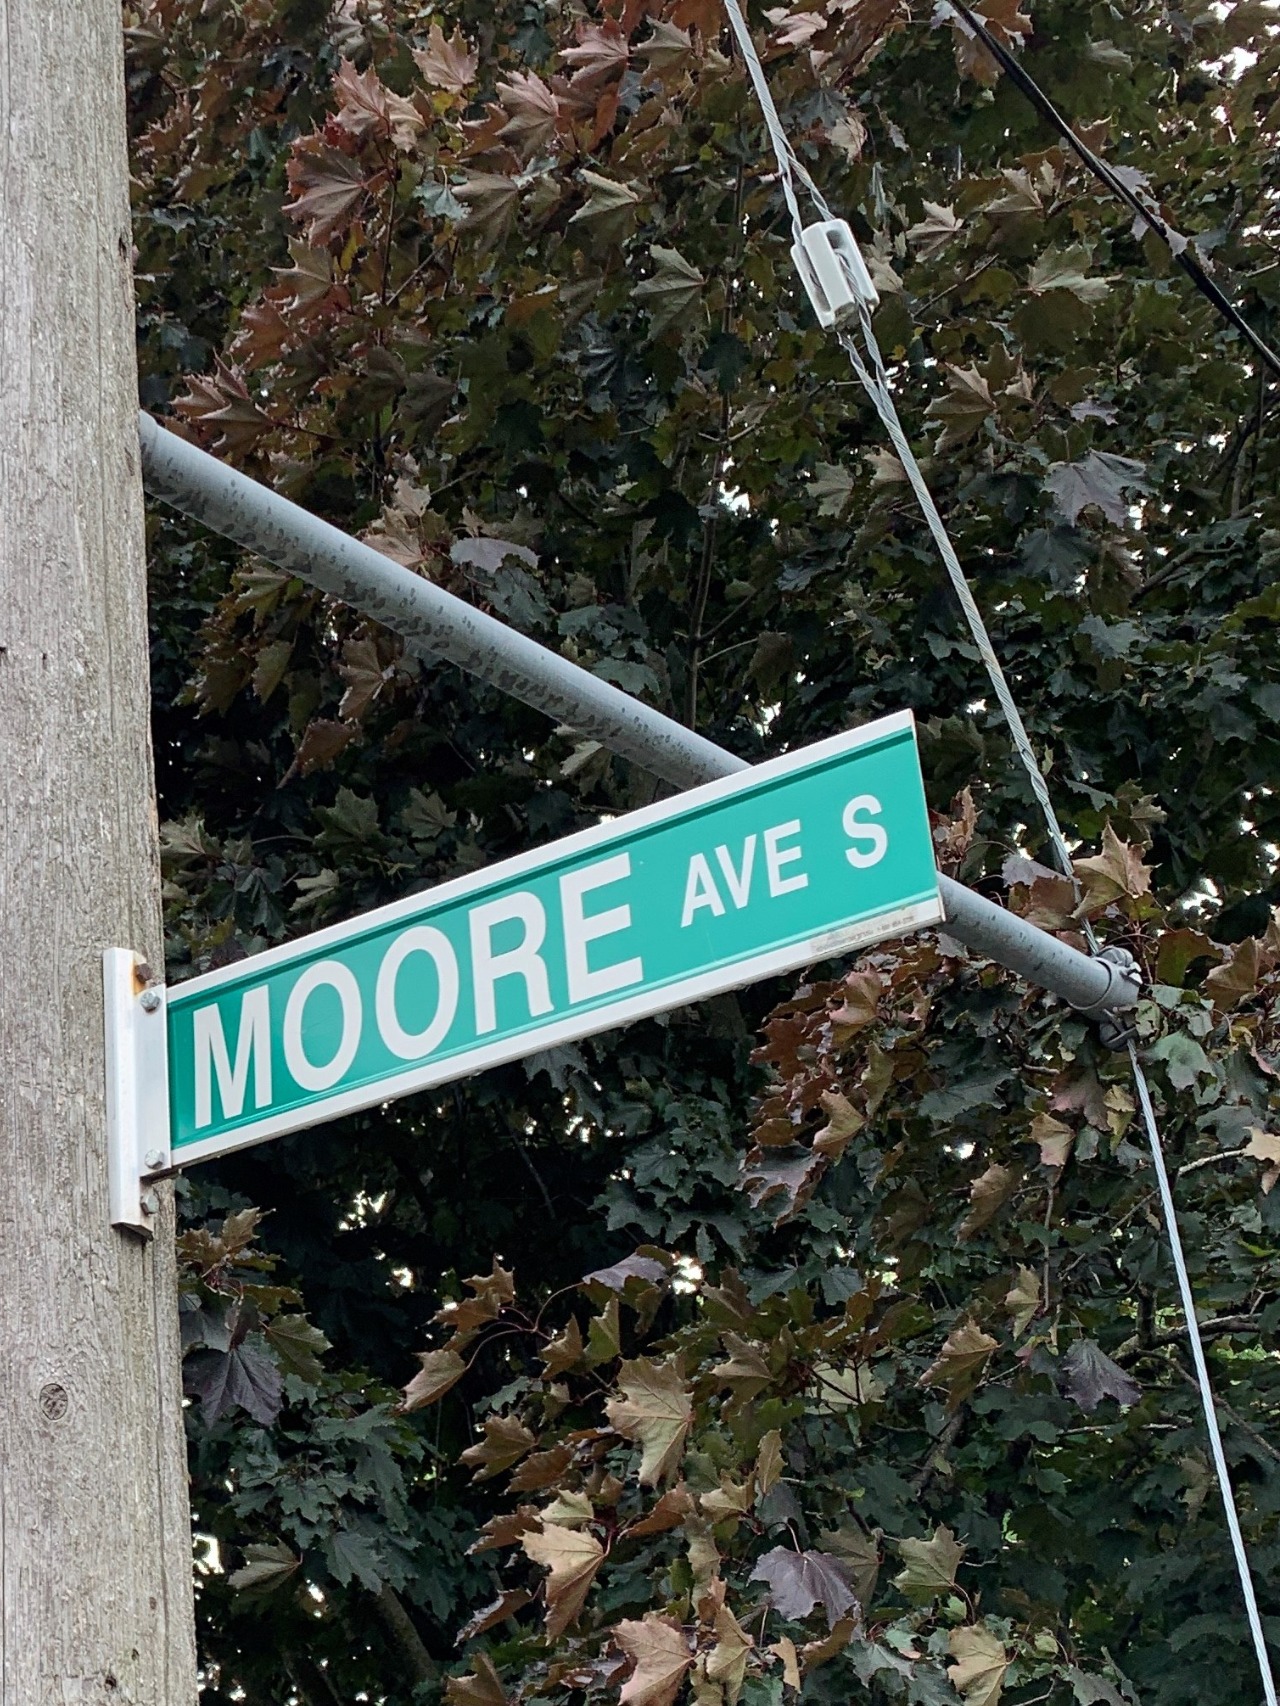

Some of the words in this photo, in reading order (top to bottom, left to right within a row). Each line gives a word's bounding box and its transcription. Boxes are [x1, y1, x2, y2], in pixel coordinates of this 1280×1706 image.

[193, 852, 644, 1129] MOORE
[680, 818, 809, 928] AVE
[841, 794, 888, 869] S
